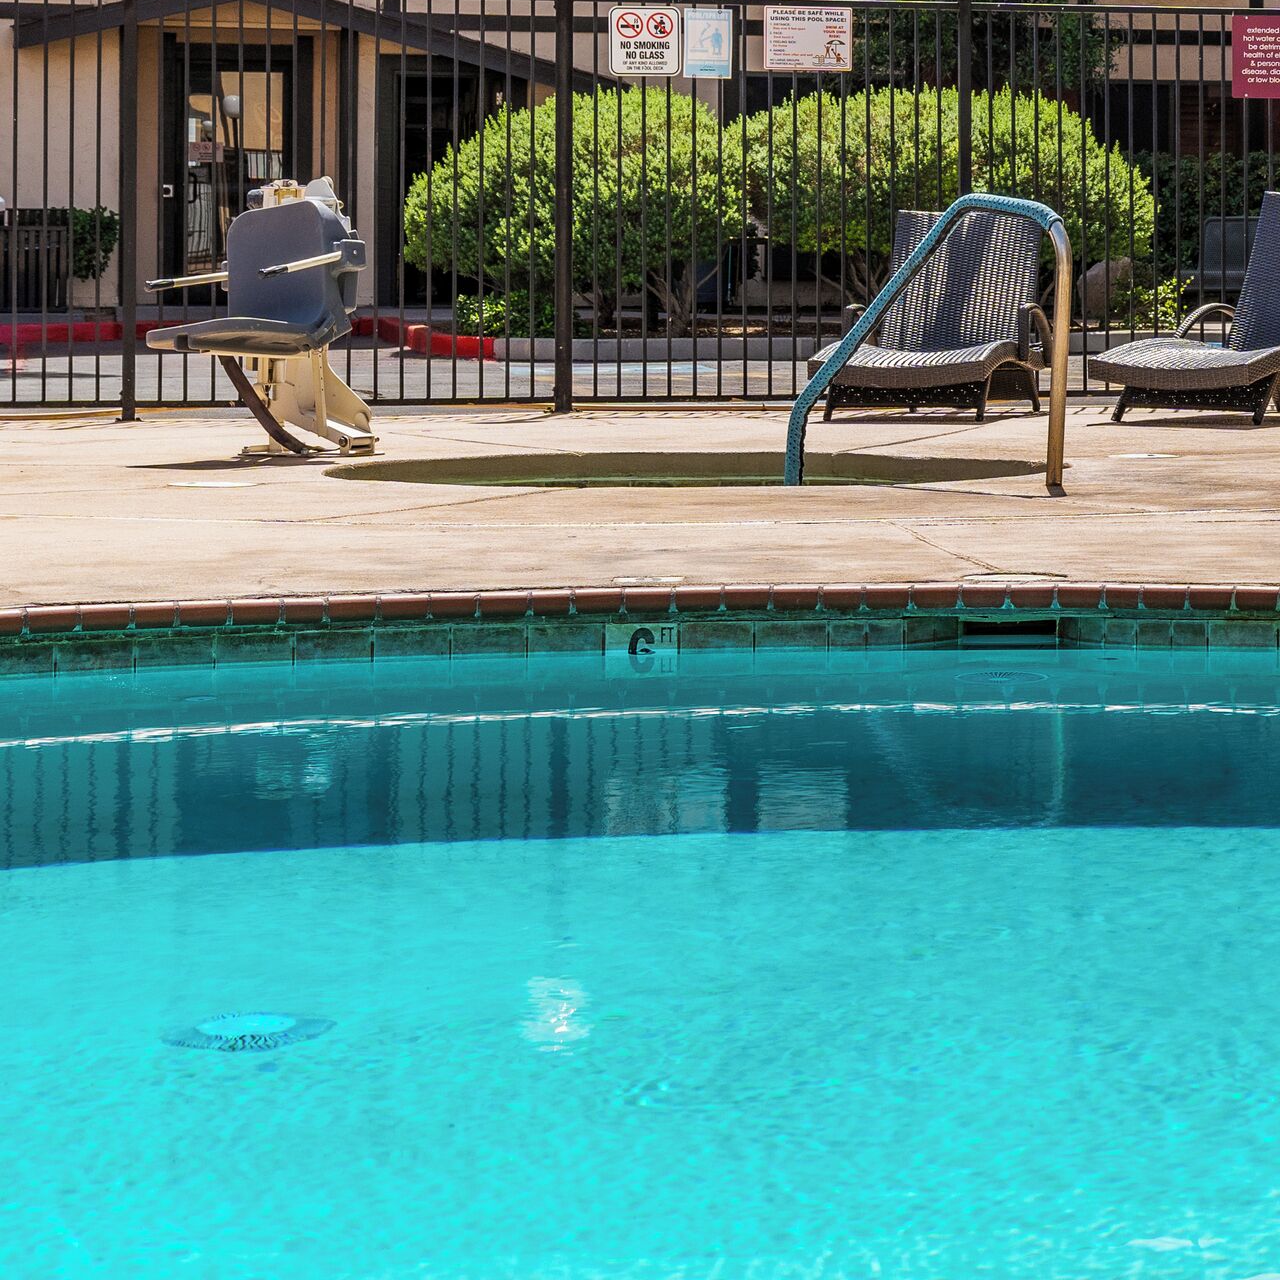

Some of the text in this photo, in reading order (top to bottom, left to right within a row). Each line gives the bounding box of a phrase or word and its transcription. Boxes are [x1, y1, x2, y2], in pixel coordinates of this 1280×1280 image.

[620, 41, 670, 50] NO SMOKING
[626, 51, 664, 59] NO GLASS
[660, 627, 674, 643] FT
